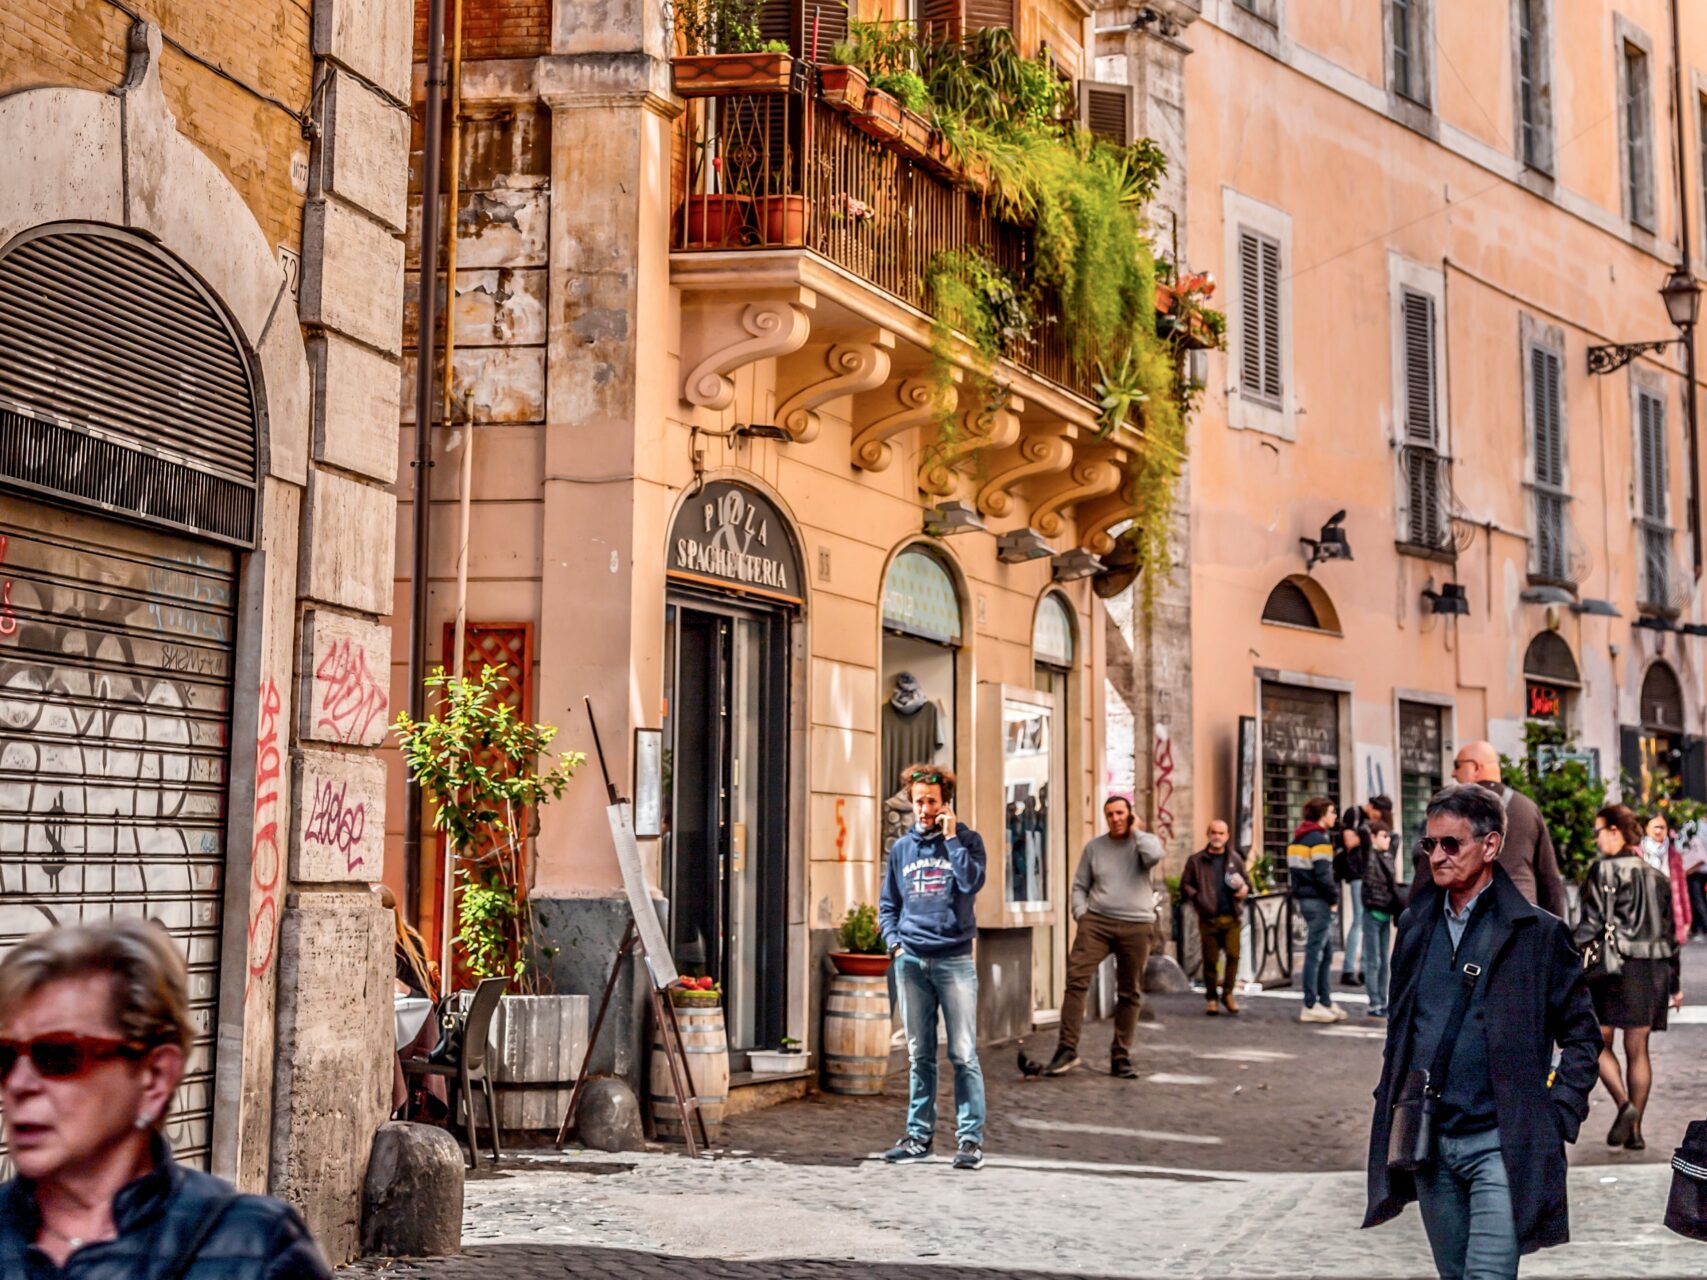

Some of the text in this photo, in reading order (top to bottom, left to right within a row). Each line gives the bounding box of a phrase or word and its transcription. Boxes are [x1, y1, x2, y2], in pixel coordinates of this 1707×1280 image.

[282, 255, 297, 295] 32
[704, 495, 767, 547] PIZZA
[677, 538, 788, 589] SPAGHETTERIA
